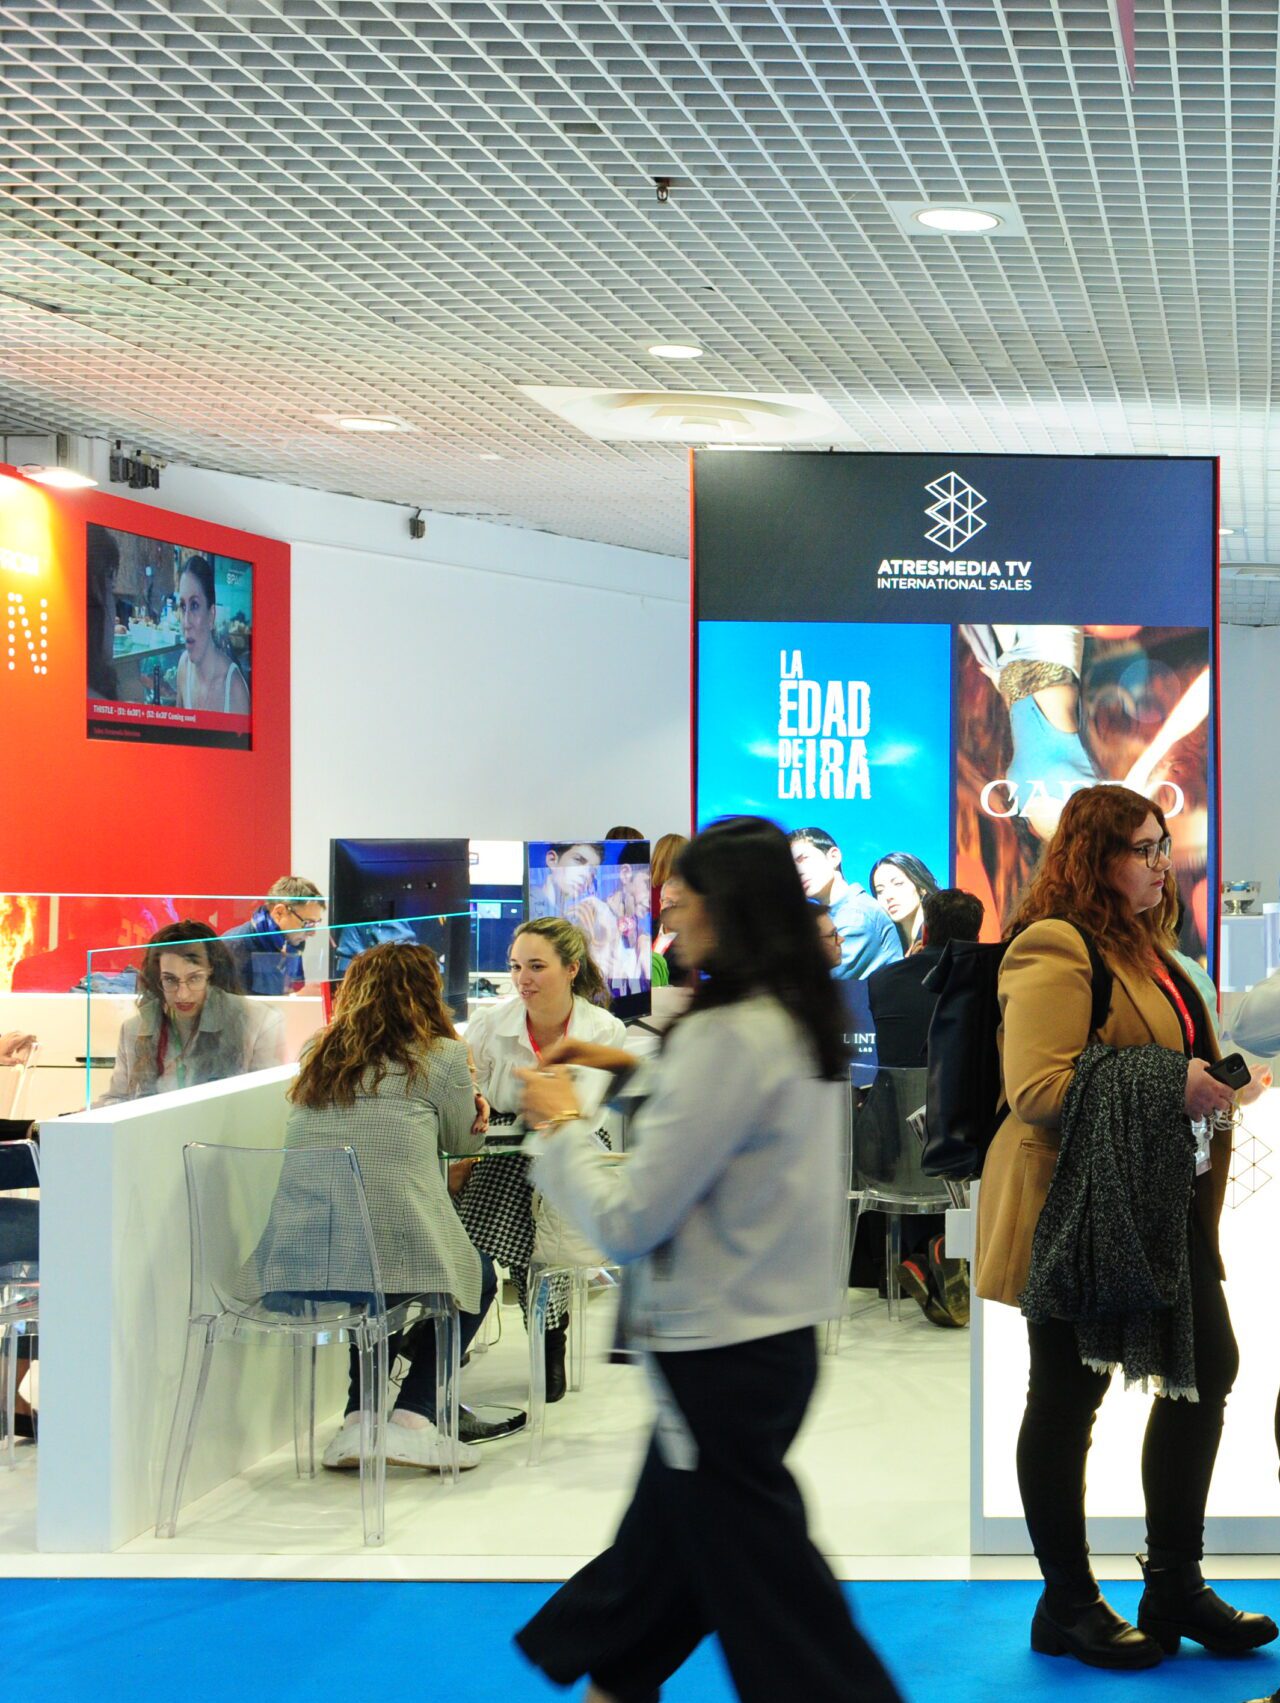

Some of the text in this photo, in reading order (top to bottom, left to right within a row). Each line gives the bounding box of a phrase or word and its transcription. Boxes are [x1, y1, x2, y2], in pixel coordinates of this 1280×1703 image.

[877, 559, 1032, 577] ATRESMEDIA TV
[877, 578, 1032, 591] INTERNATIONAL SALES
[780, 650, 804, 679] LA
[778, 680, 871, 737] EDAD
[778, 739, 803, 768] DE
[805, 738, 872, 800] IRA
[778, 769, 803, 799] LA
[979, 779, 1185, 819] CAO
